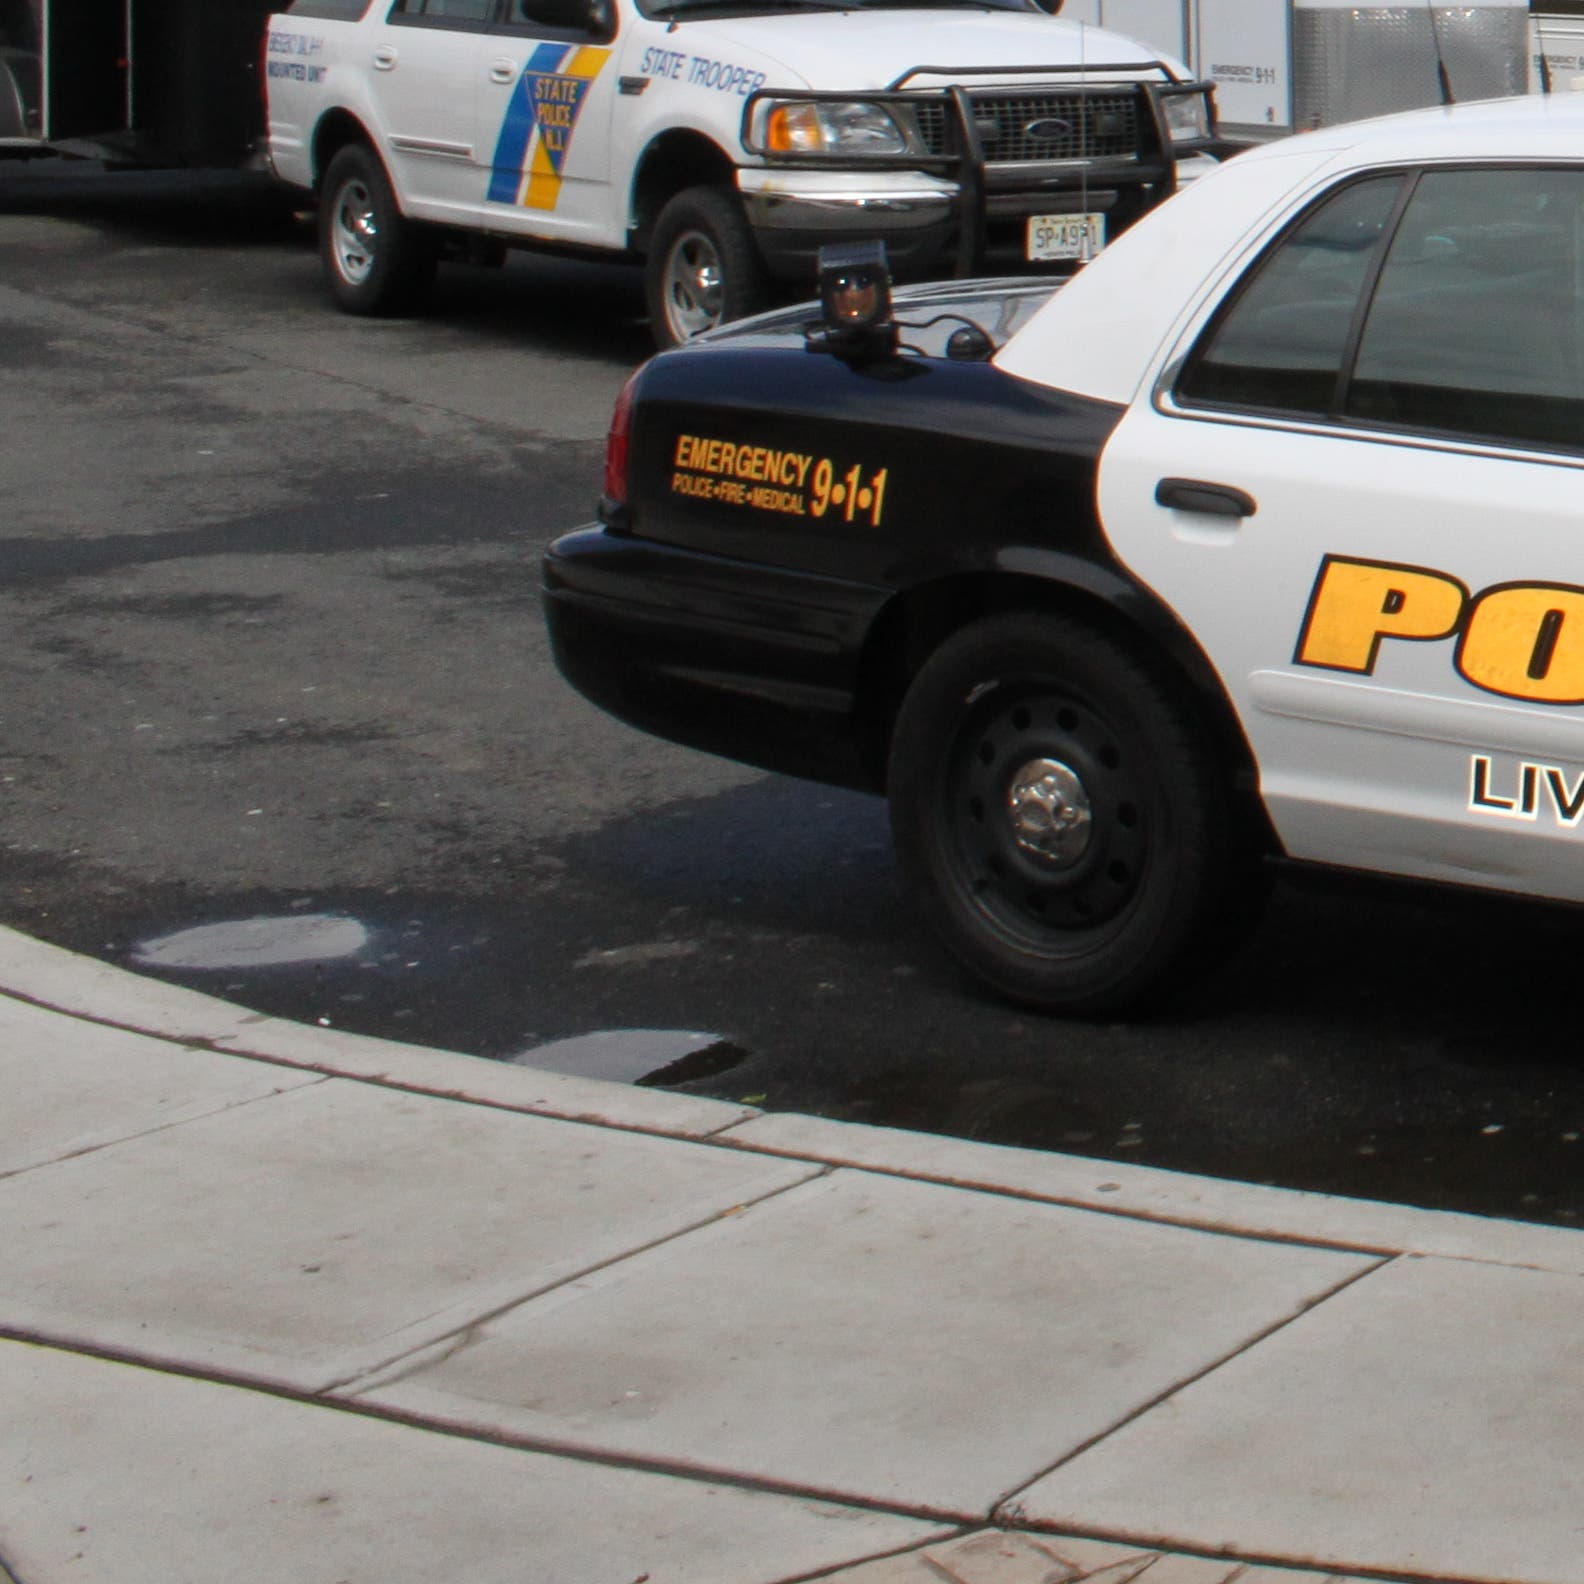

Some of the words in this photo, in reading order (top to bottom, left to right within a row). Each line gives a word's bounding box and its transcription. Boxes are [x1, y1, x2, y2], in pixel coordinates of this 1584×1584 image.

[535, 77, 577, 103] STATE
[641, 46, 687, 81] STATE
[688, 56, 767, 96] TROOPER
[537, 102, 571, 127] POLICE
[674, 434, 813, 488] EMERGENCY
